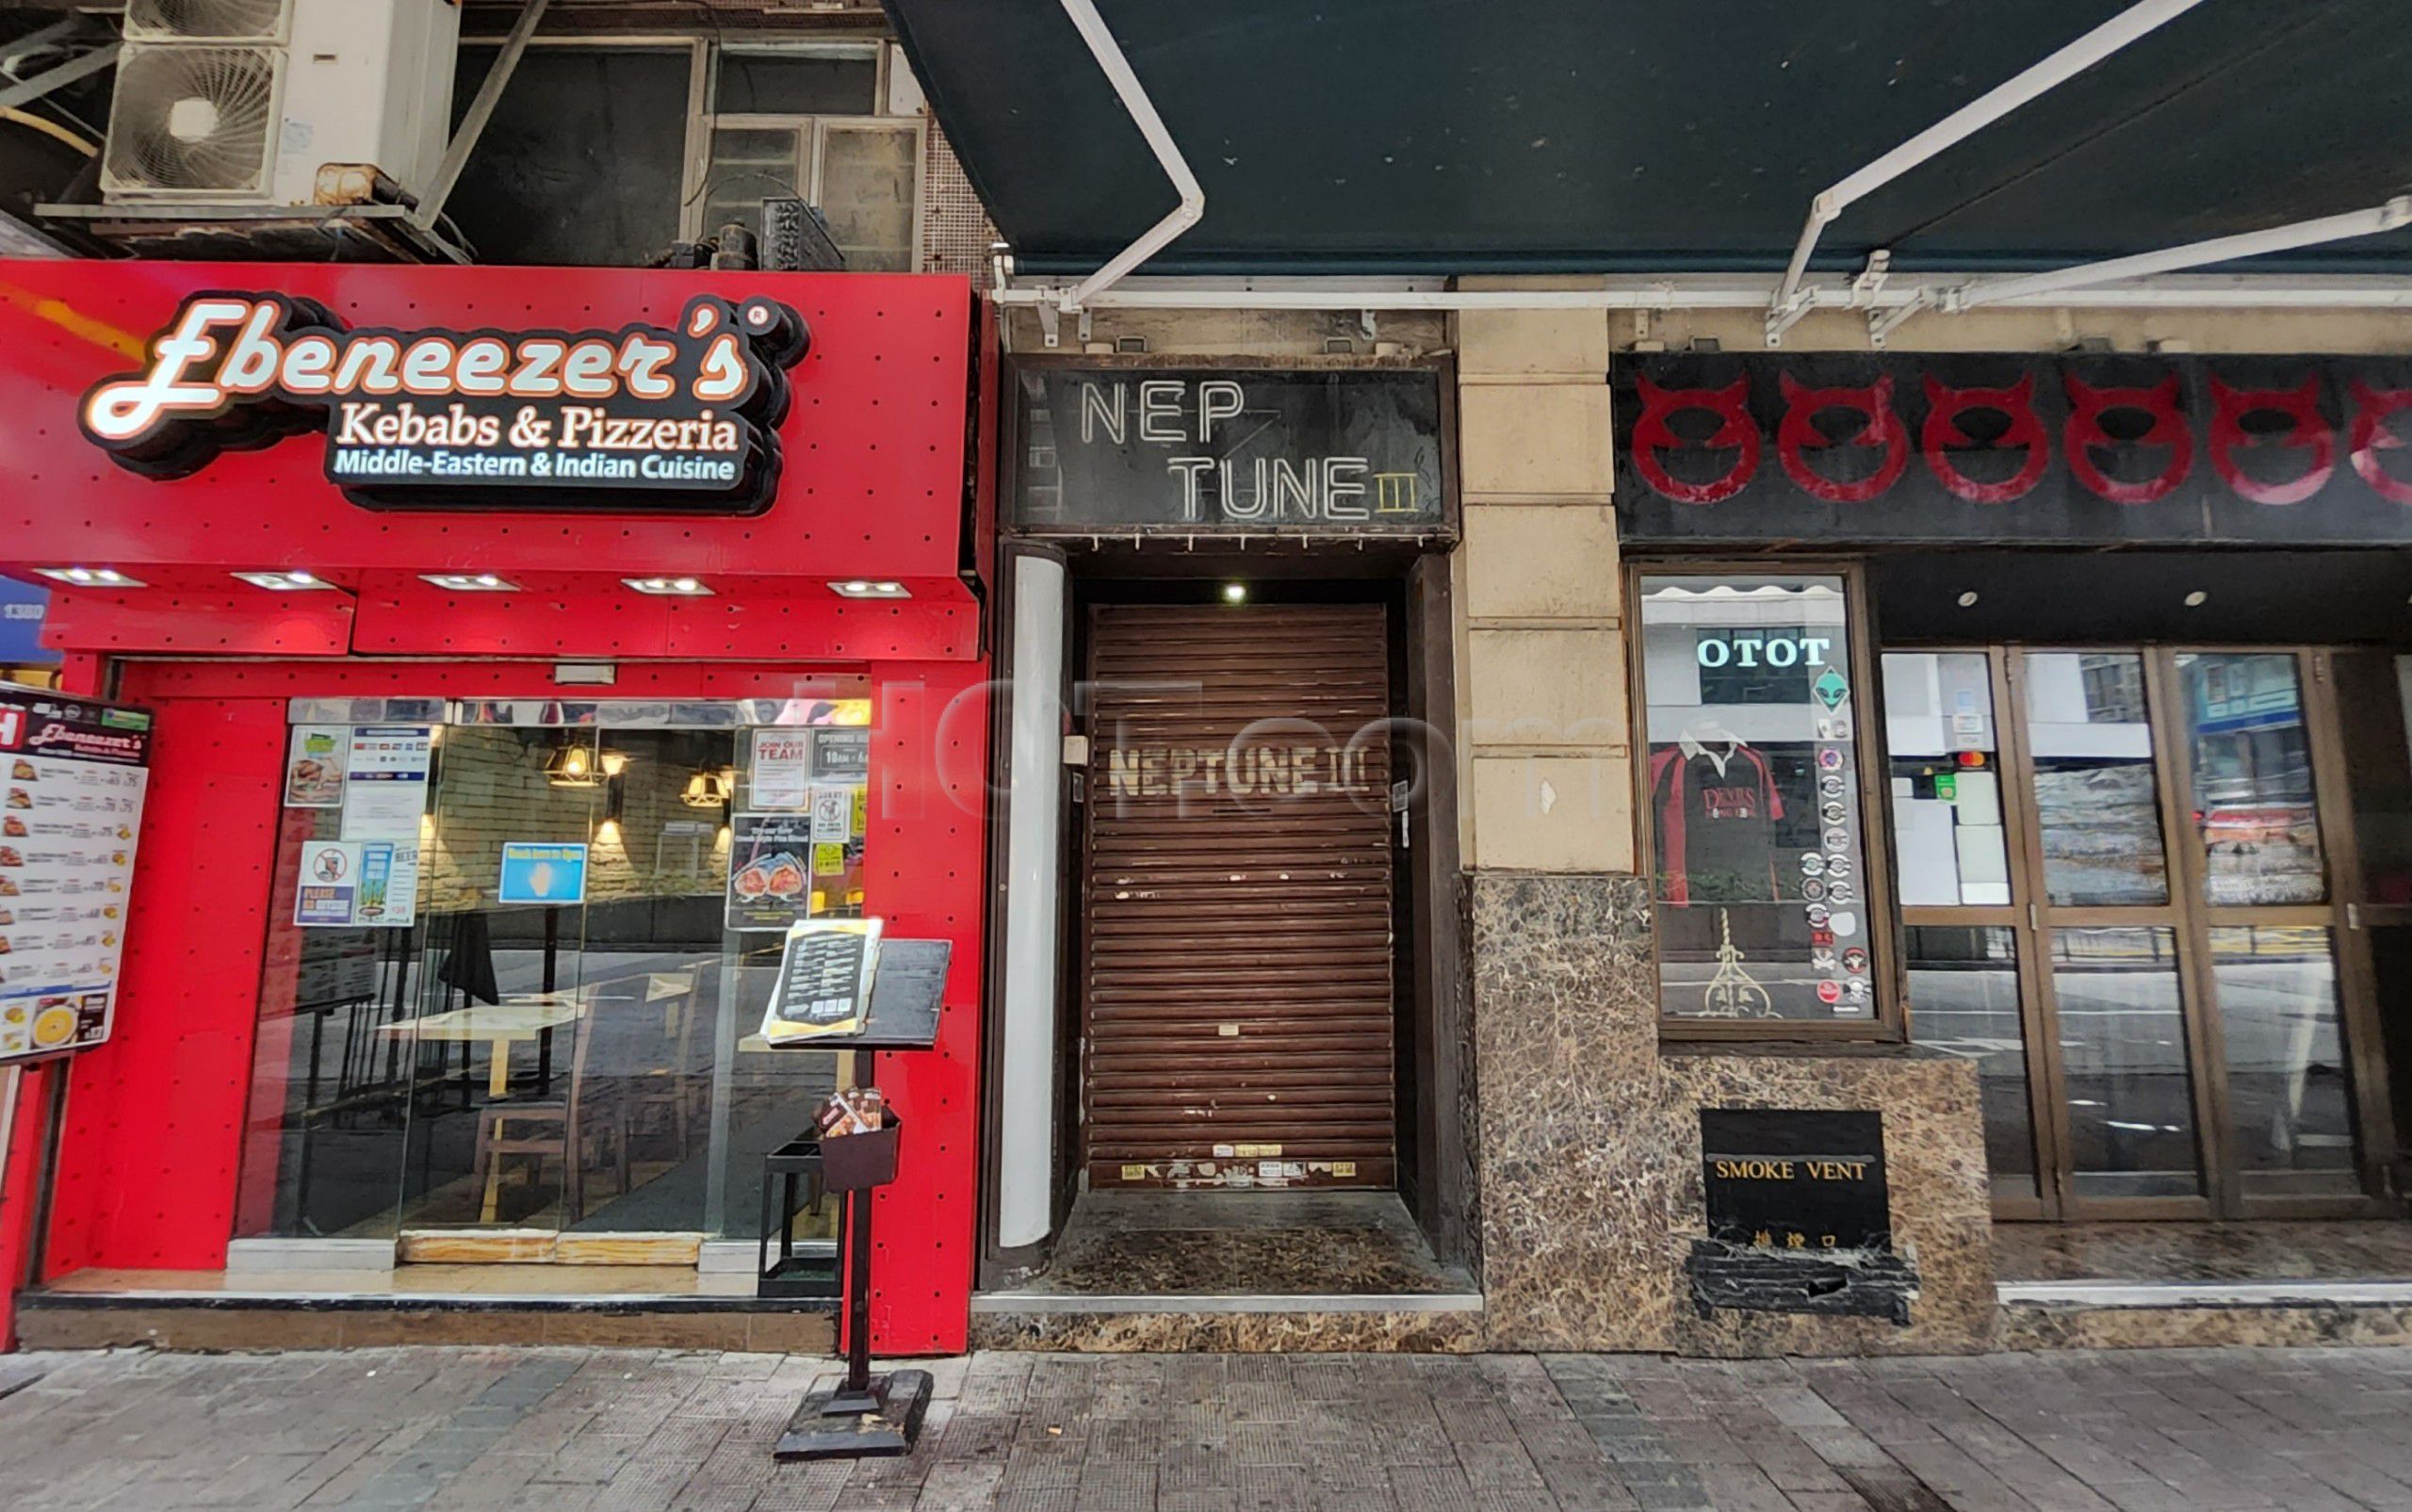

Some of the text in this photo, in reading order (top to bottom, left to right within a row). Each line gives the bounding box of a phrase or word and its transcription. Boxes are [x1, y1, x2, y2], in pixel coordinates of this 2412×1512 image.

[87, 299, 750, 439] Ebeneezer's
[335, 402, 739, 451] Kebabs & Pizzeria
[1080, 380, 1246, 445] NEP
[334, 449, 735, 480] Middle-Eastern & Indian Cuisine
[1166, 456, 1371, 521] TUNE
[1697, 638, 1831, 668] OTOT
[758, 740, 781, 749] JOIN
[758, 749, 804, 760] TEAM
[1109, 746, 1317, 797] NEPTUNE
[1715, 1160, 1867, 1180] SMOKE VENT
